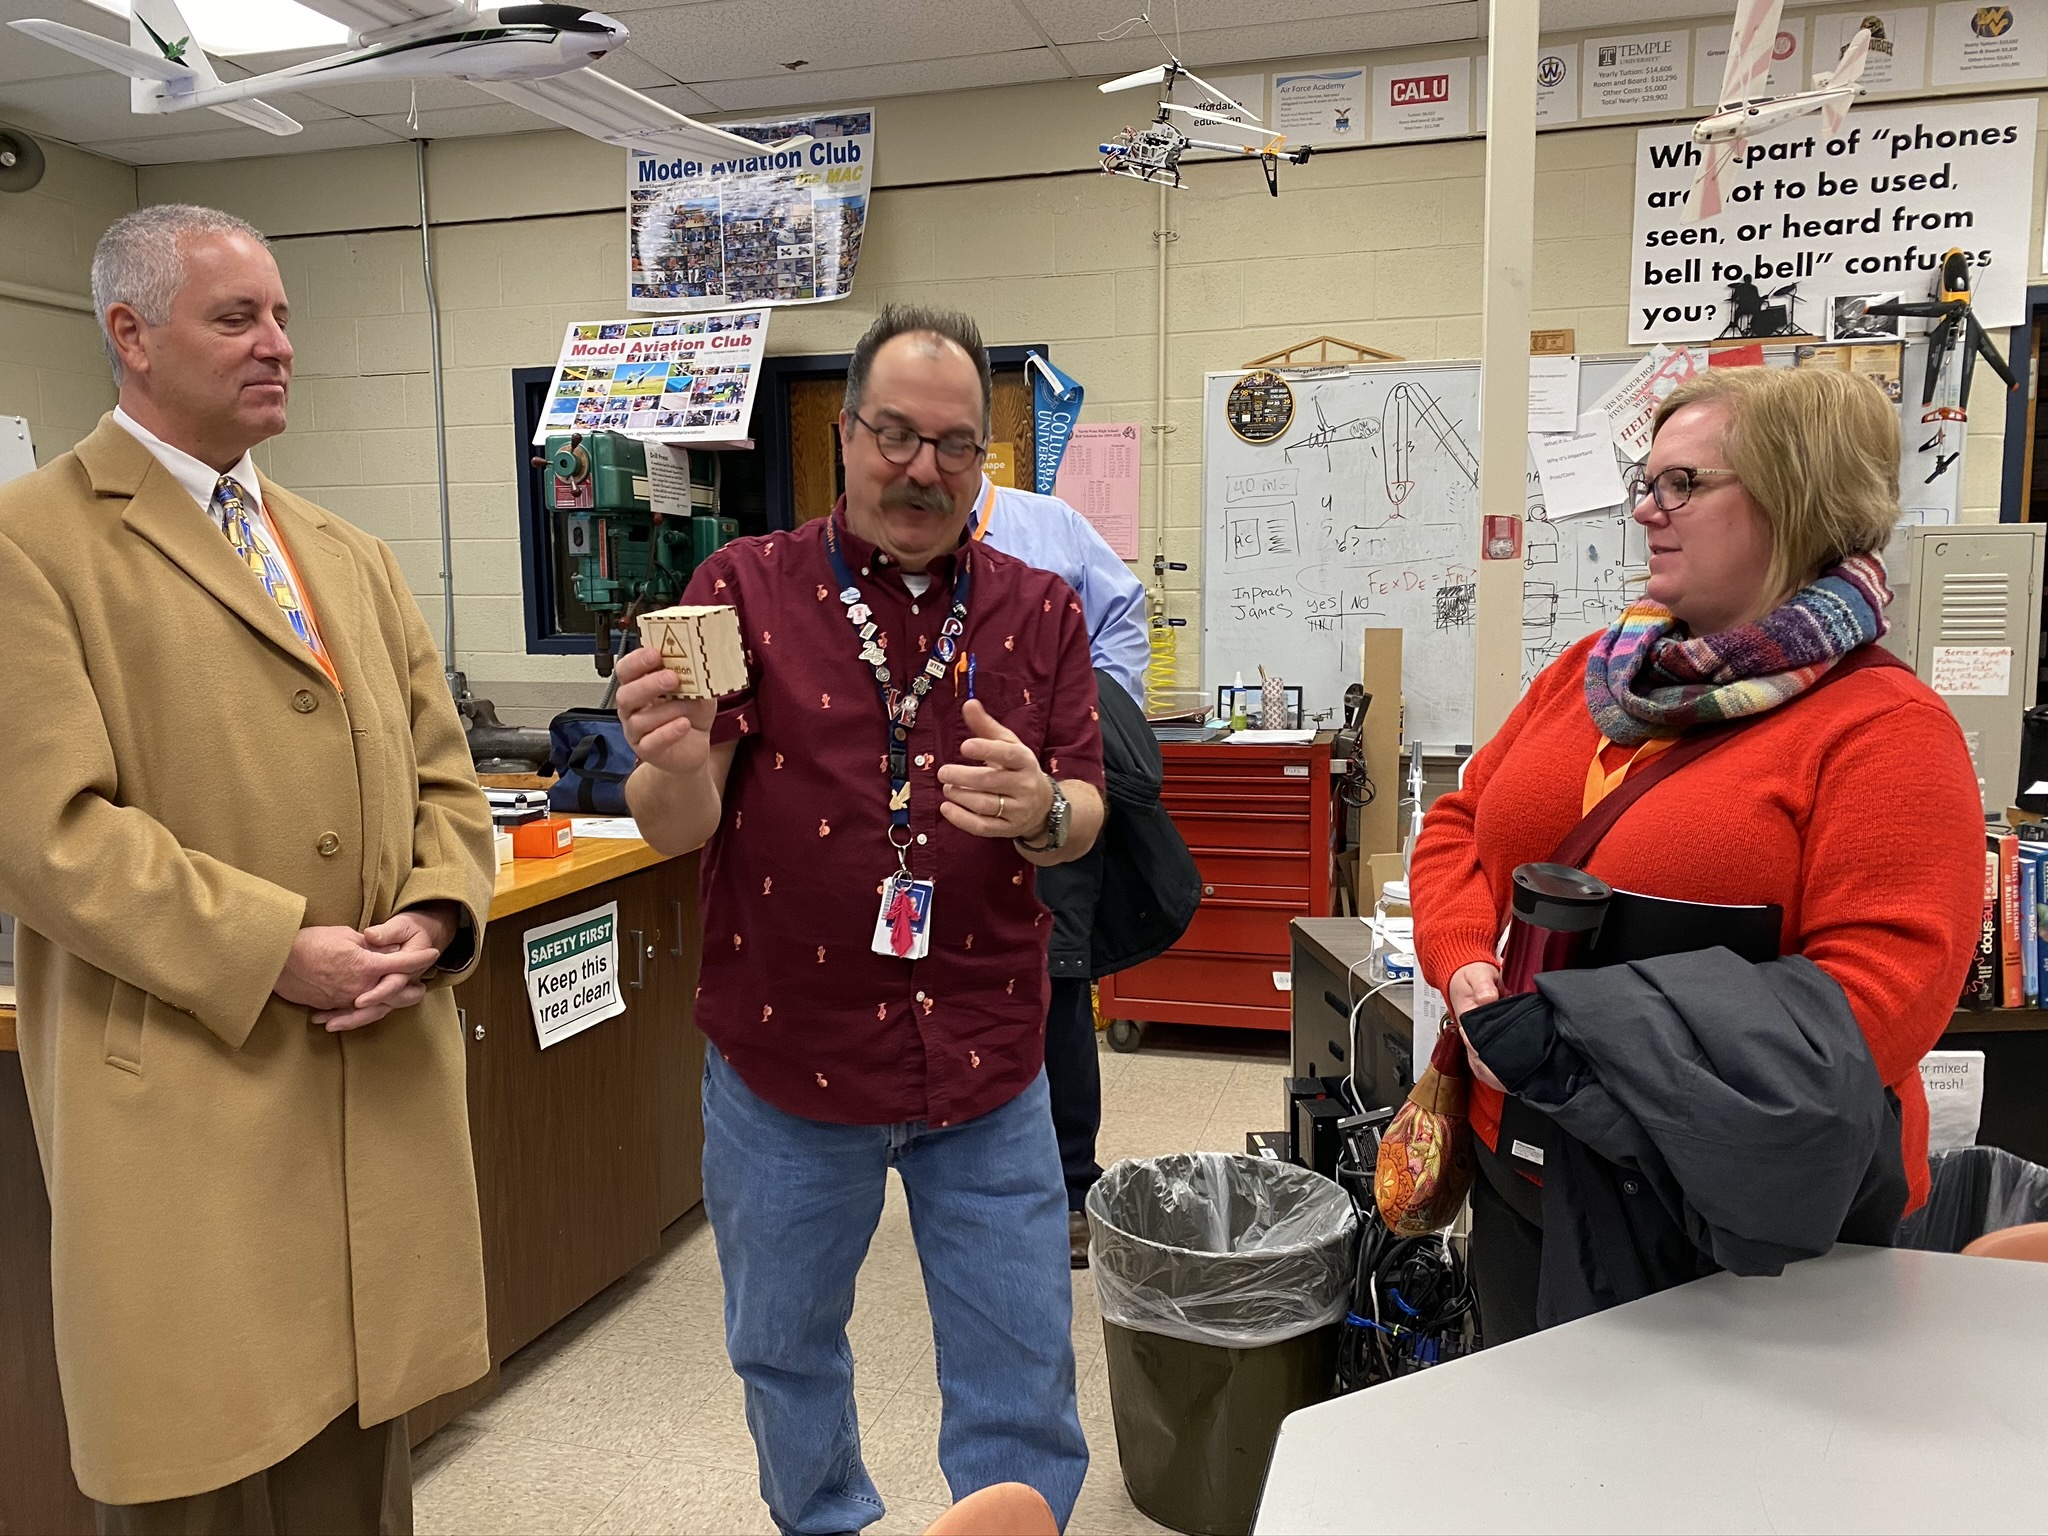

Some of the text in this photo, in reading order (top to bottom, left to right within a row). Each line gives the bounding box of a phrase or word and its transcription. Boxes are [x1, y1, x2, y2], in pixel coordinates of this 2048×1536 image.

[1618, 41, 1672, 57] TEMPLE
[1594, 80, 1612, 88] Room
[1598, 70, 1618, 78] Yearly
[1280, 86, 1291, 94] Air
[1312, 83, 1345, 91] Academy
[1393, 78, 1446, 102] CAL U
[1644, 84, 1667, 93] $5,000
[1746, 136, 1816, 170] part
[1826, 129, 1861, 156] of
[639, 158, 703, 182] Model
[809, 140, 861, 166] Club
[826, 165, 864, 184] MAC
[1774, 179, 1806, 200] to
[1818, 171, 1858, 197] be
[1870, 164, 1958, 194] used,
[1646, 206, 1974, 247] seen, or heard from
[1644, 259, 1700, 286] bell
[1712, 257, 1745, 281] to
[1642, 304, 1717, 330] you?
[571, 334, 752, 356] Model Aviation Club
[1622, 377, 1642, 395] YOUR
[1609, 405, 1626, 420] FIVE
[1620, 408, 1652, 441] HELP
[1635, 432, 1650, 448] IT
[1568, 450, 1593, 460] important
[530, 922, 612, 965] SAFETY FIRST
[538, 956, 607, 998] Keep this
[573, 980, 610, 1009] clean
[1933, 1062, 1968, 1074] mixed
[1930, 1078, 1964, 1090] trash!
